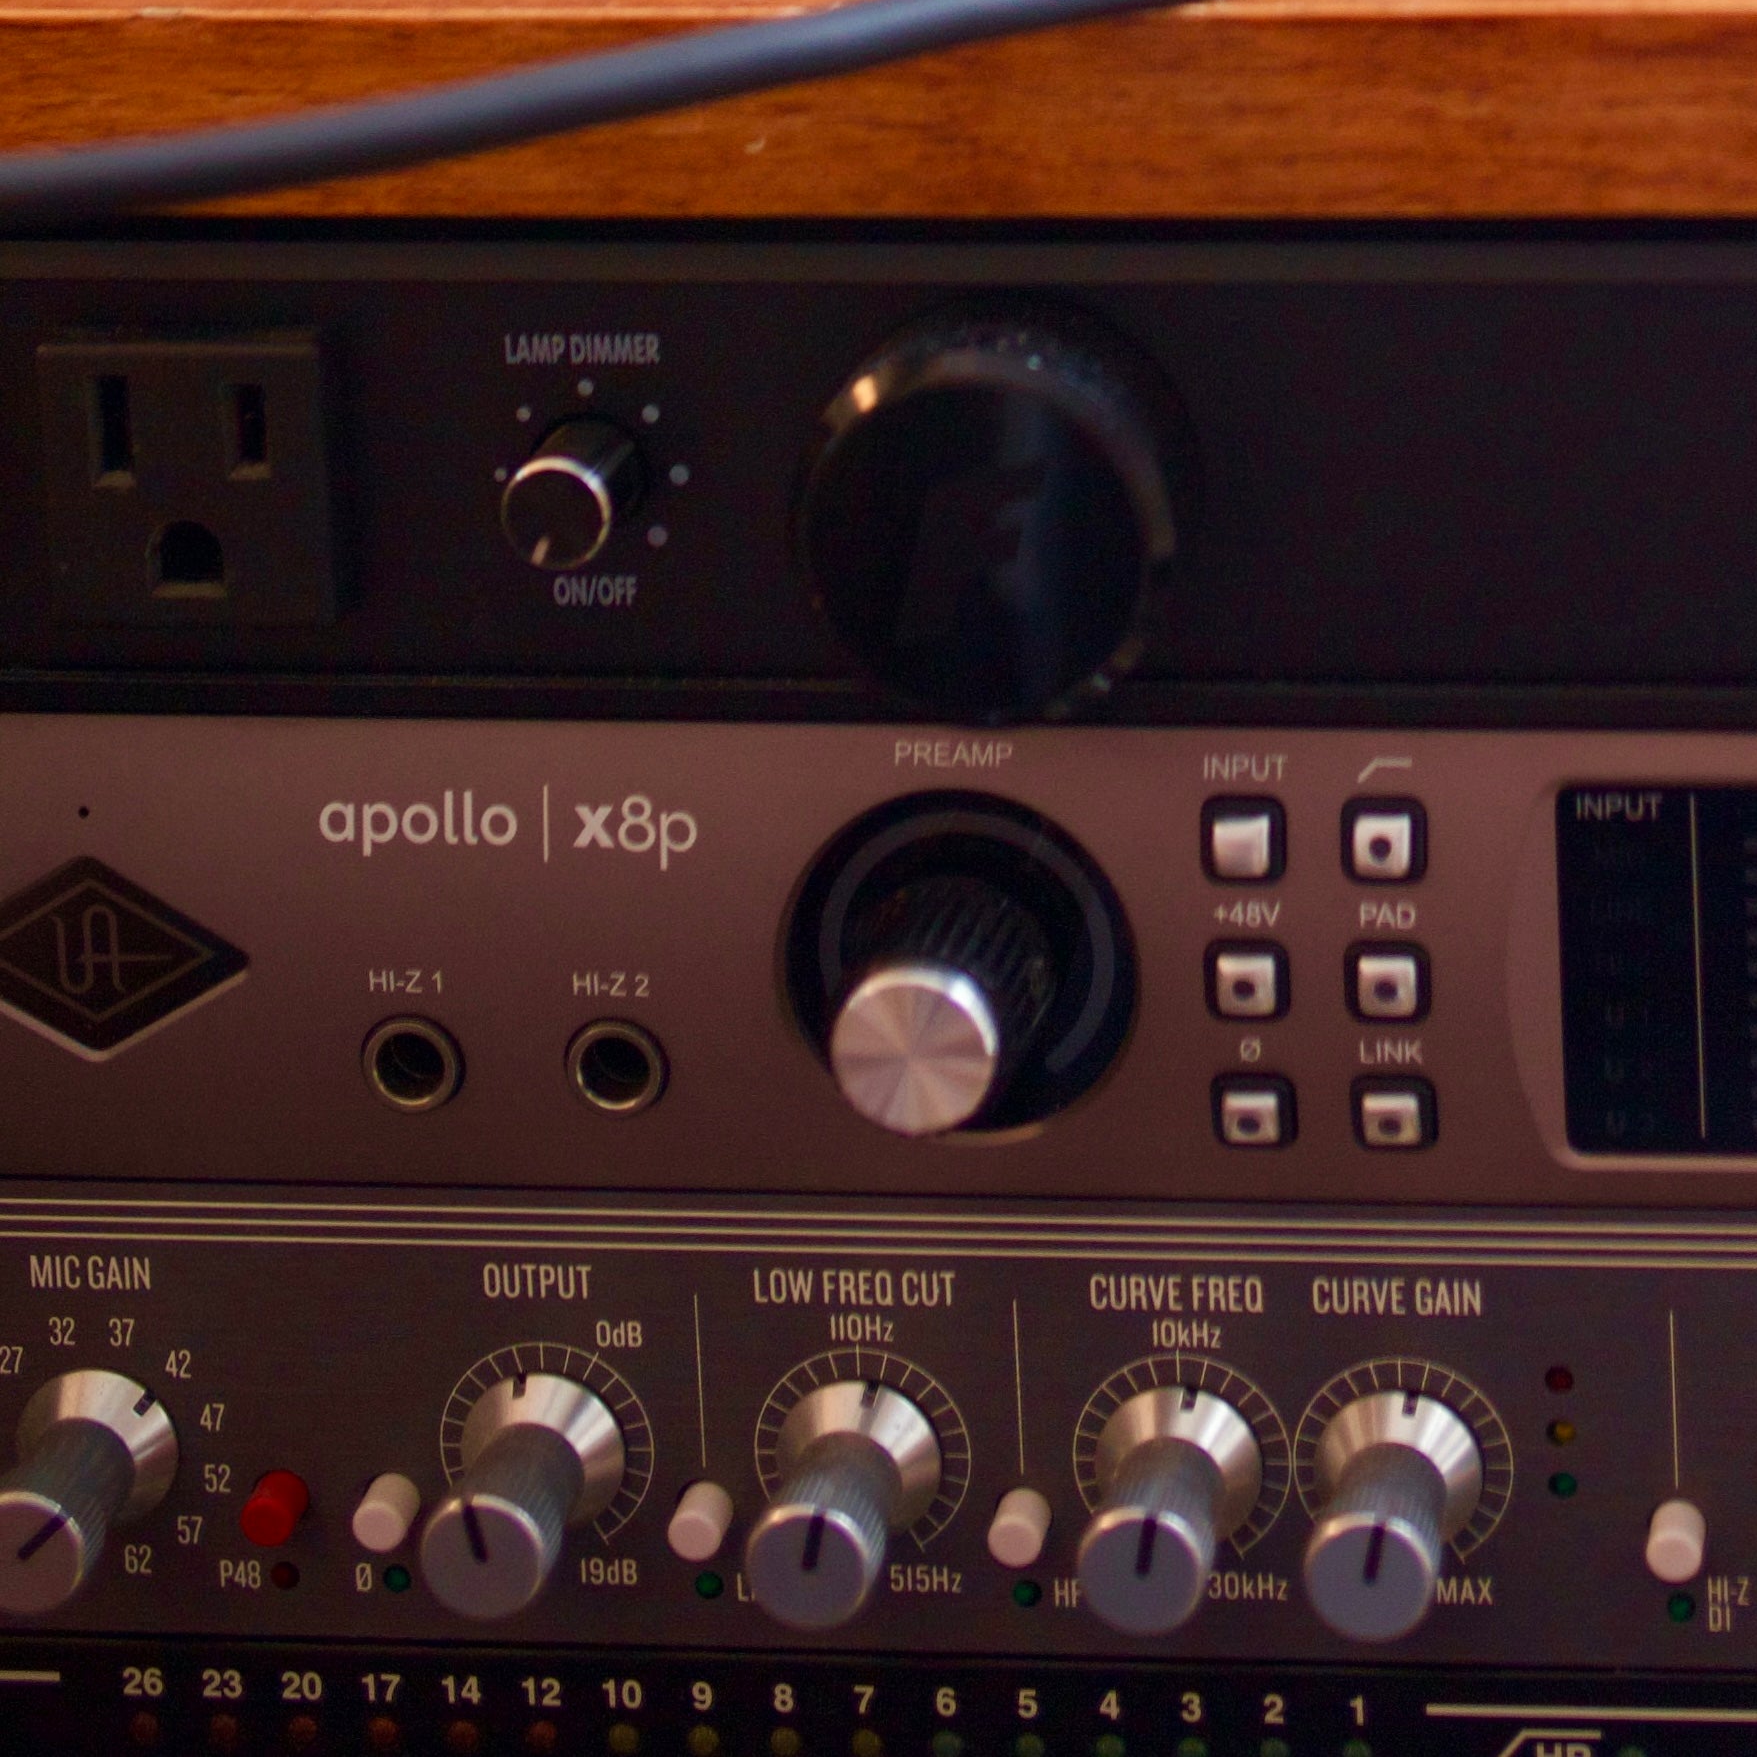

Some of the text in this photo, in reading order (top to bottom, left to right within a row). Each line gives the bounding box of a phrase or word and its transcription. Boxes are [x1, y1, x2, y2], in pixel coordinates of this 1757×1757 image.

[504, 334, 660, 365] LAMP DIMMER
[553, 575, 637, 607] ON/OFF
[894, 741, 1013, 768] PREAMP
[1203, 754, 1287, 782] INPUT
[1574, 792, 1662, 822] INPUT
[319, 789, 697, 871] apollo x8p
[1212, 901, 1281, 929] +48V
[1358, 902, 1417, 930] PAD
[368, 970, 443, 993] HI-Z 1
[572, 972, 651, 997] HI-Z 2
[1359, 1039, 1423, 1065] LINK
[29, 1255, 151, 1290] MIC GAIN
[482, 1263, 592, 1300] OUTPUT
[753, 1269, 955, 1307] LOW FREQ CUT
[1089, 1275, 1264, 1313] CURVE FREQ
[1312, 1277, 1482, 1317] CURVE GAIN
[49, 1317, 75, 1345] 32
[109, 1318, 134, 1346] 37
[830, 1315, 894, 1343] 110Hz
[1152, 1320, 1221, 1349] 10kHz
[0, 1345, 24, 1374] 27
[165, 1350, 192, 1379] 42
[200, 1403, 225, 1431] 47
[203, 1464, 231, 1492] 52
[176, 1516, 202, 1545] 57
[124, 1545, 152, 1574] 62
[219, 1559, 261, 1588] P48
[579, 1558, 638, 1585] 19dB
[1207, 1571, 1289, 1600] 30kHz
[1434, 1577, 1494, 1605] MAX
[123, 1667, 1364, 1726] 26 23 20 17 14 12 10 9 8 7 6 5 4 3 2 1
